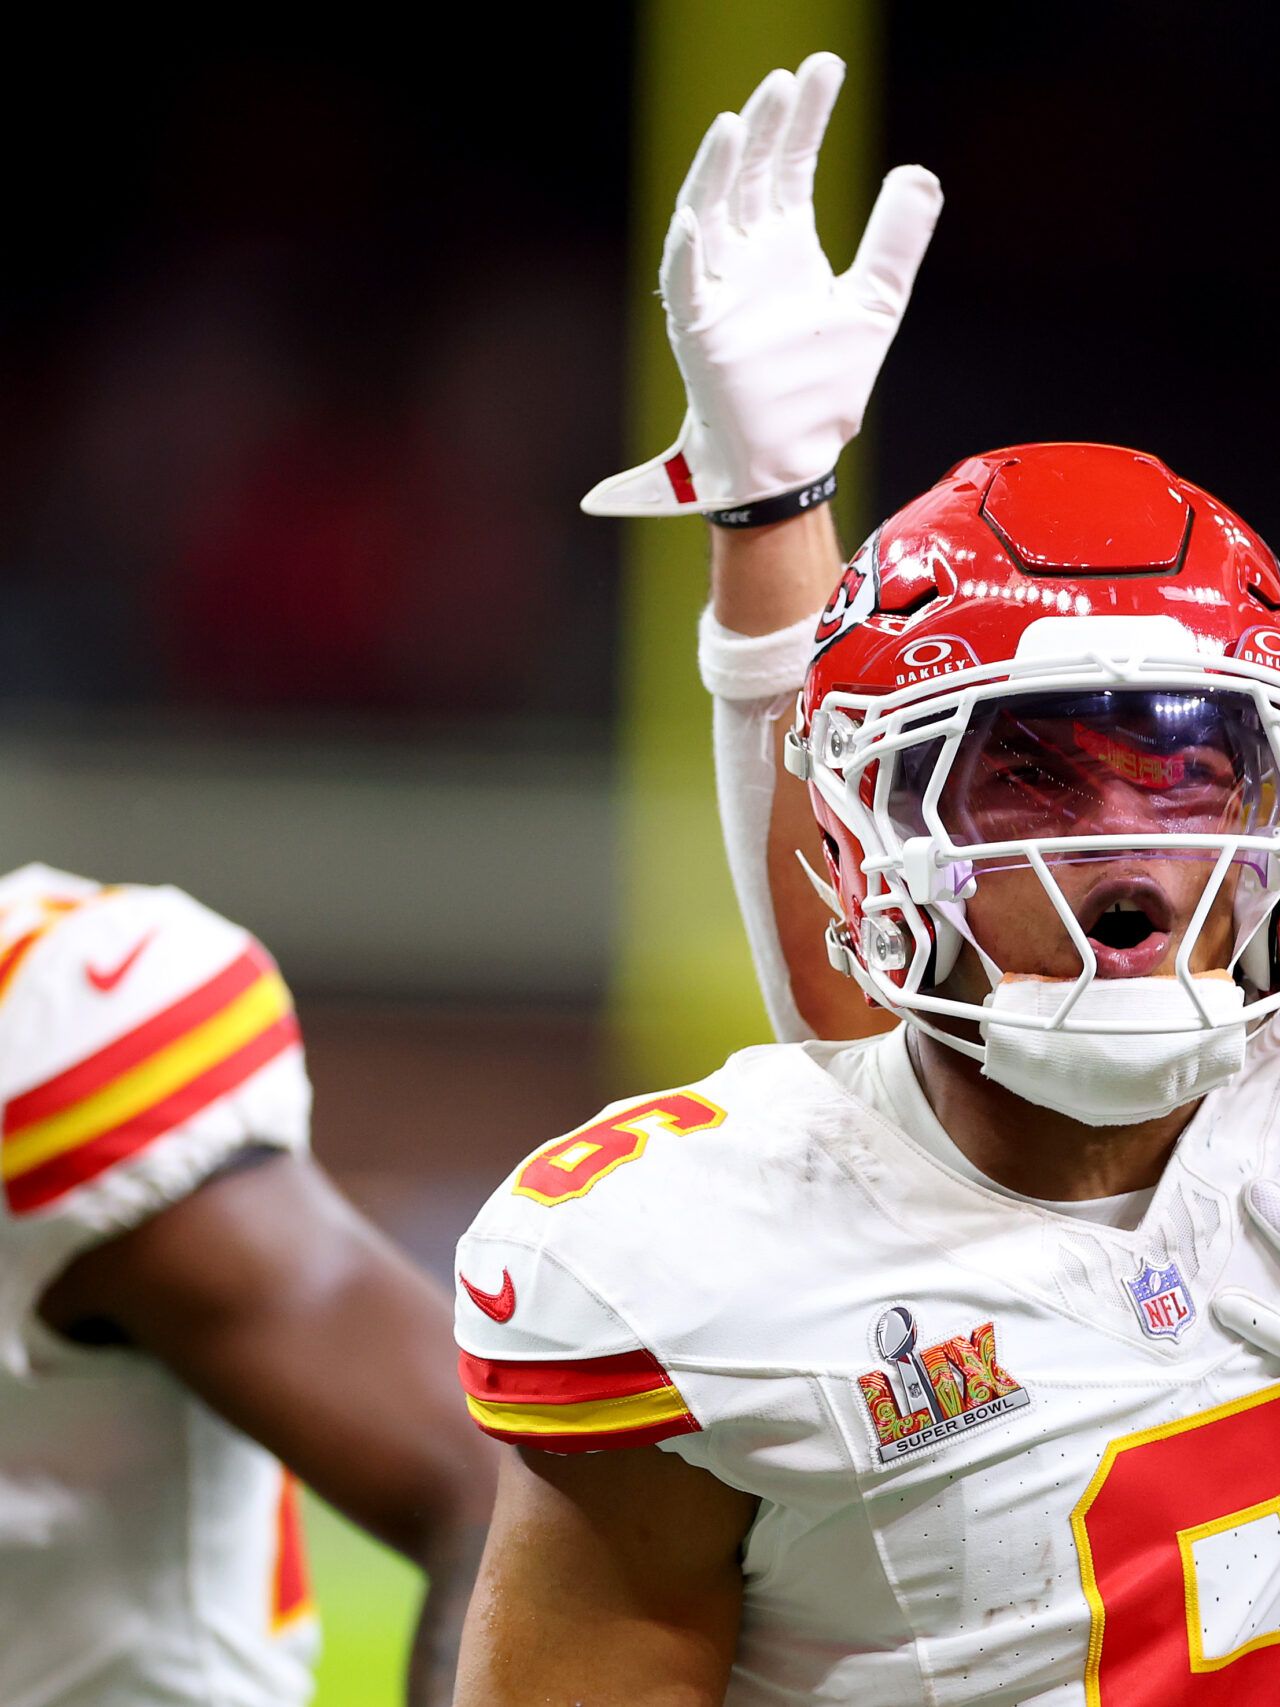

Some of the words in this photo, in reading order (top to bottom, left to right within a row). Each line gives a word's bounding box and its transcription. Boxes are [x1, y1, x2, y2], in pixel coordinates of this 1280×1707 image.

[896, 660, 966, 686] OAKLEY
[511, 1089, 729, 1209] 6
[1143, 1291, 1188, 1329] NFL
[858, 1321, 1023, 1447] LIX
[896, 1420, 958, 1453] SUPER
[963, 1398, 1015, 1426] BOWL
